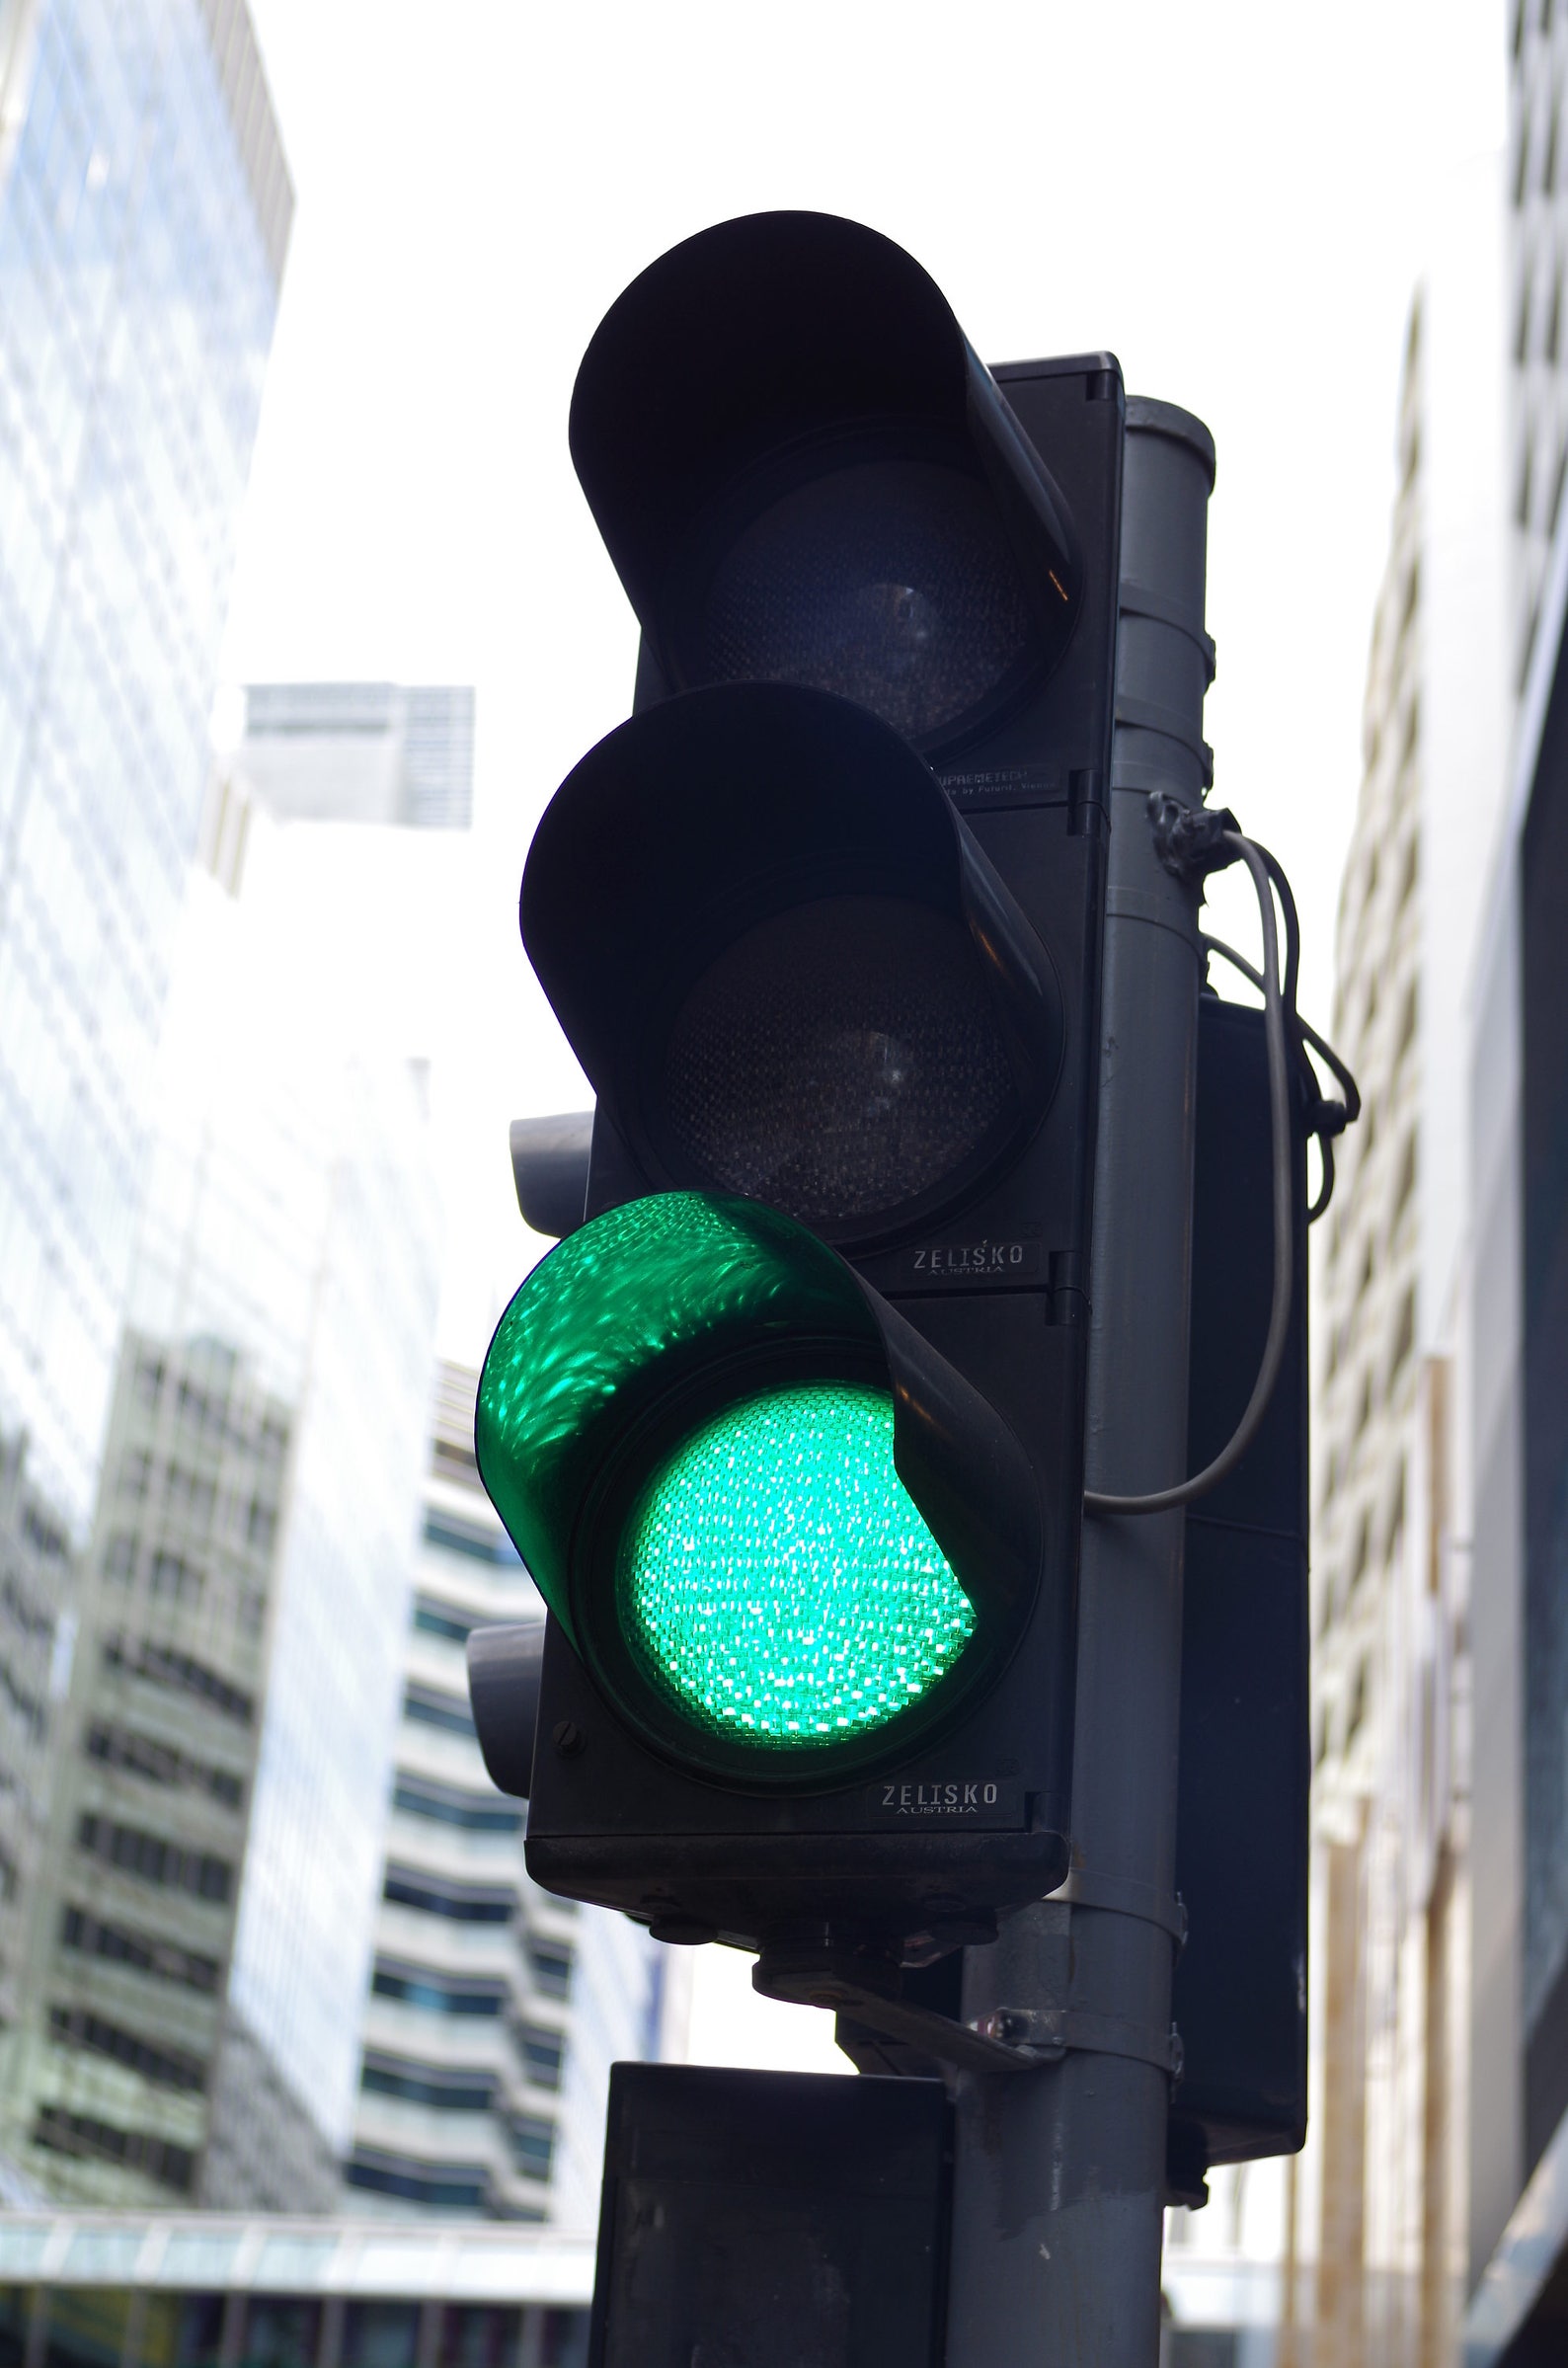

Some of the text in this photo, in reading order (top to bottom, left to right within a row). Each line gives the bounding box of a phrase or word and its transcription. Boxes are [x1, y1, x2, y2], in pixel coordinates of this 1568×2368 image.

[939, 770, 1028, 787] UPREMETECH
[913, 1245, 1023, 1269] ZELISKO
[928, 1265, 1004, 1276] AUSTRIA
[882, 1783, 997, 1805] ZELISKO
[896, 1805, 978, 1814] AUSTRIA
